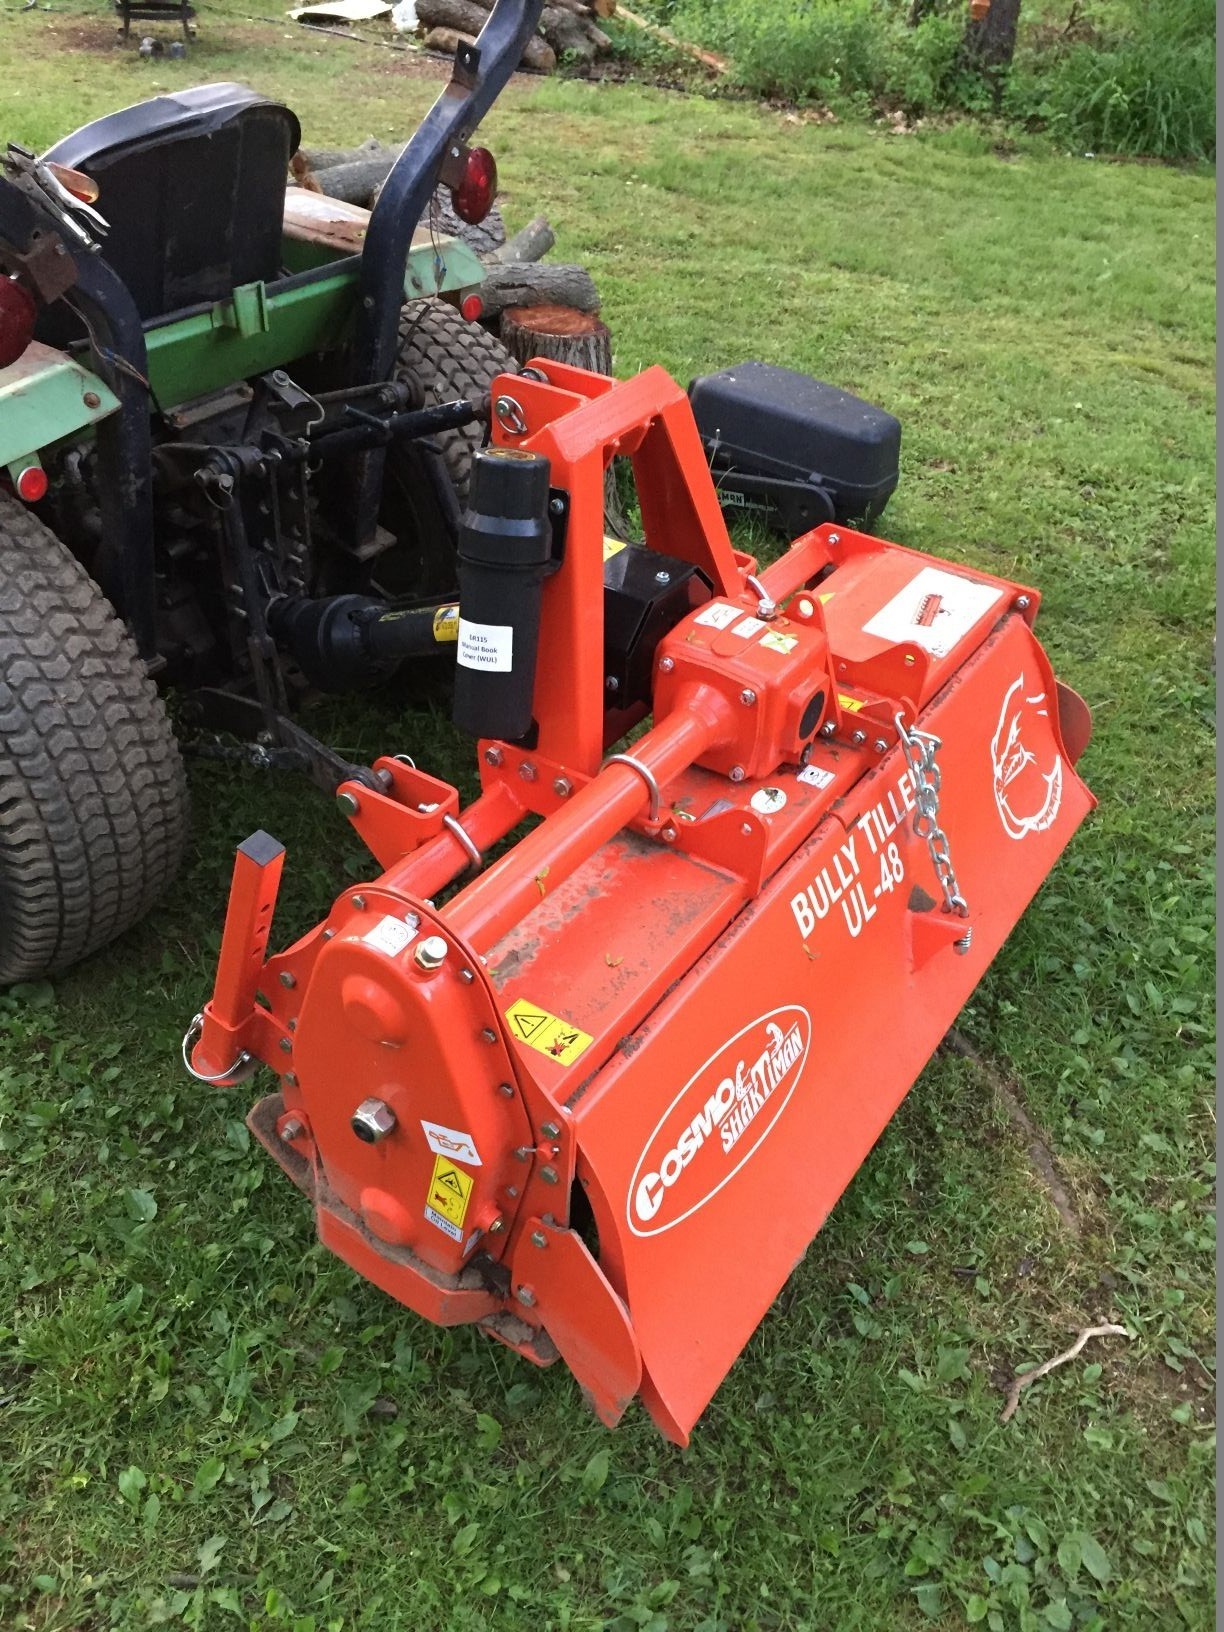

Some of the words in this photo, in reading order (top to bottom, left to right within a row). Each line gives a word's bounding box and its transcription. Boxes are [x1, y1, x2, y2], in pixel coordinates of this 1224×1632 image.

[477, 655, 498, 664] (WUL)
[481, 646, 498, 654] Book
[790, 834, 861, 940] BULLY
[841, 882, 877, 938] UL
[720, 1025, 804, 1154] SHAKTIMAN
[635, 1077, 735, 1222] COSMO
[430, 1215, 440, 1225] Oil
[440, 1222, 457, 1236] Level
[431, 1210, 457, 1232] Maintain
